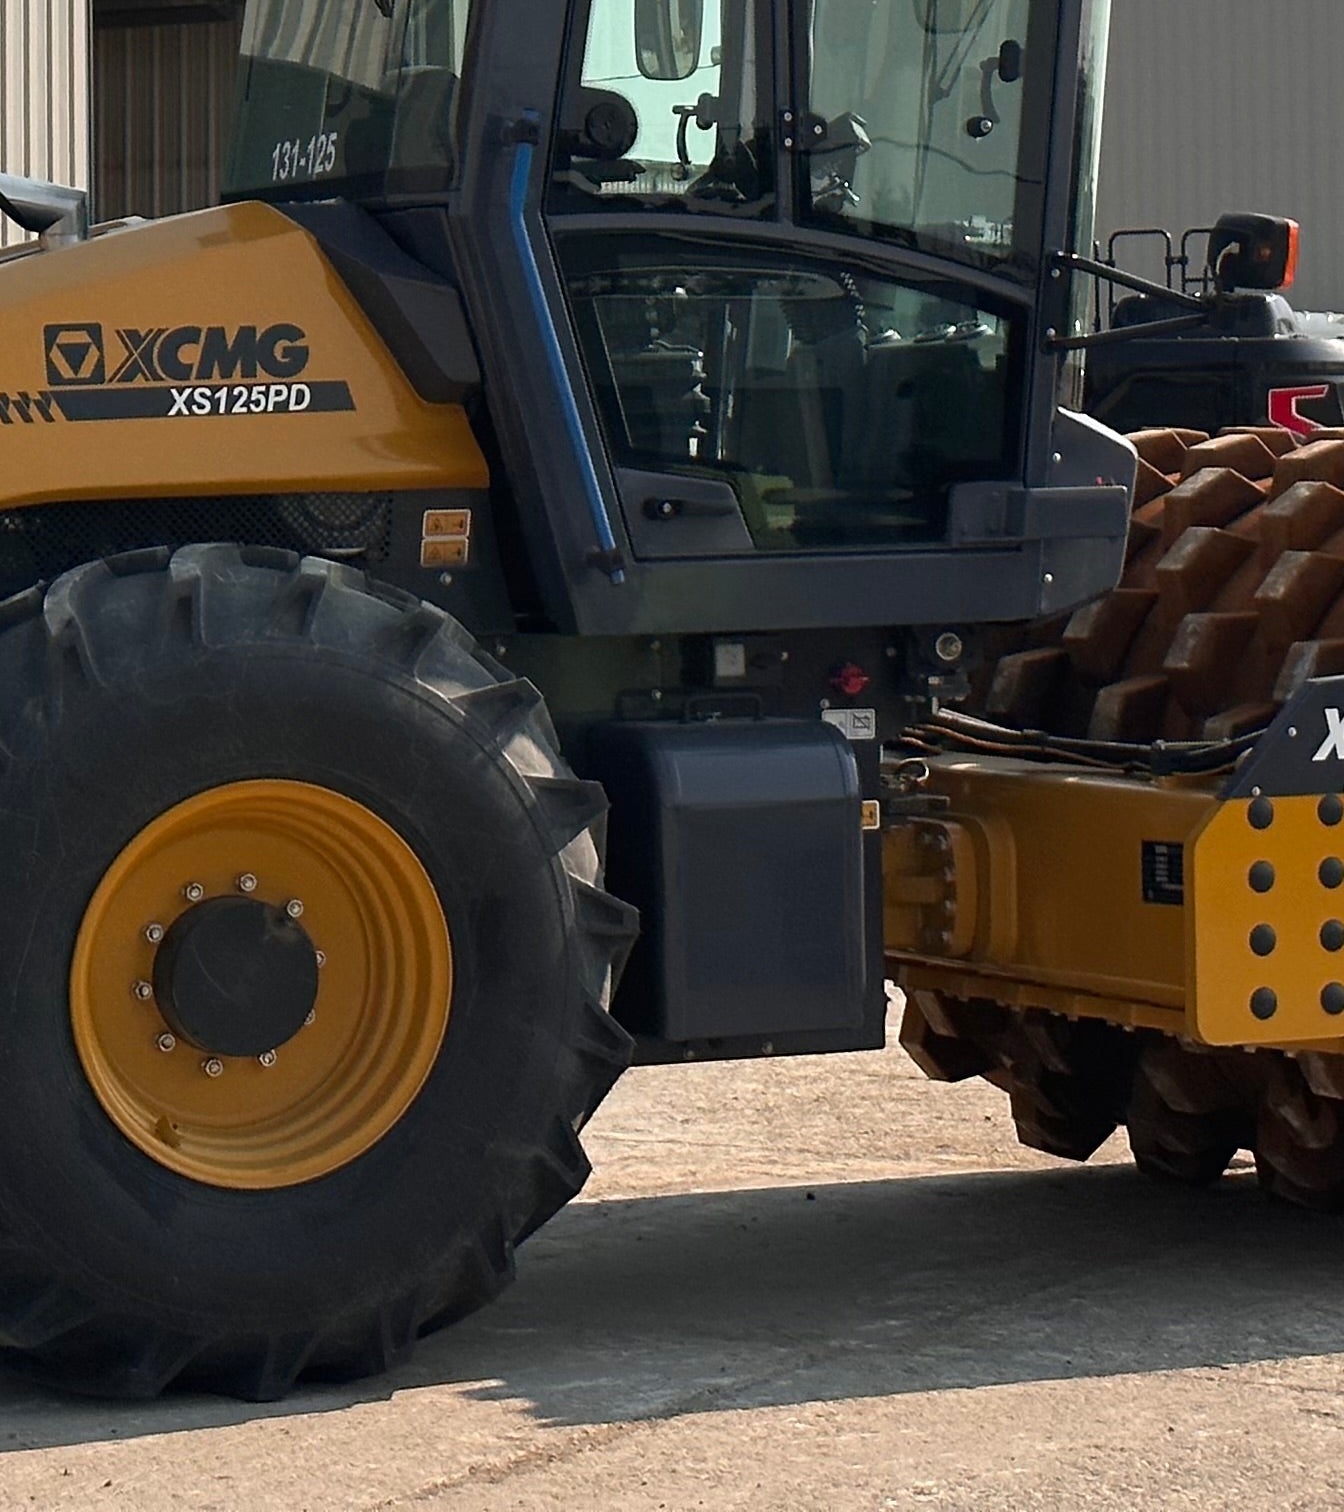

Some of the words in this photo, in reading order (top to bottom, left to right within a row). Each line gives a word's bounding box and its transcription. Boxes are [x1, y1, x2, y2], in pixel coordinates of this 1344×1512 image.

[272, 132, 337, 181] 131-125
[107, 323, 310, 384] XCMG
[167, 383, 311, 416] XS125PD
